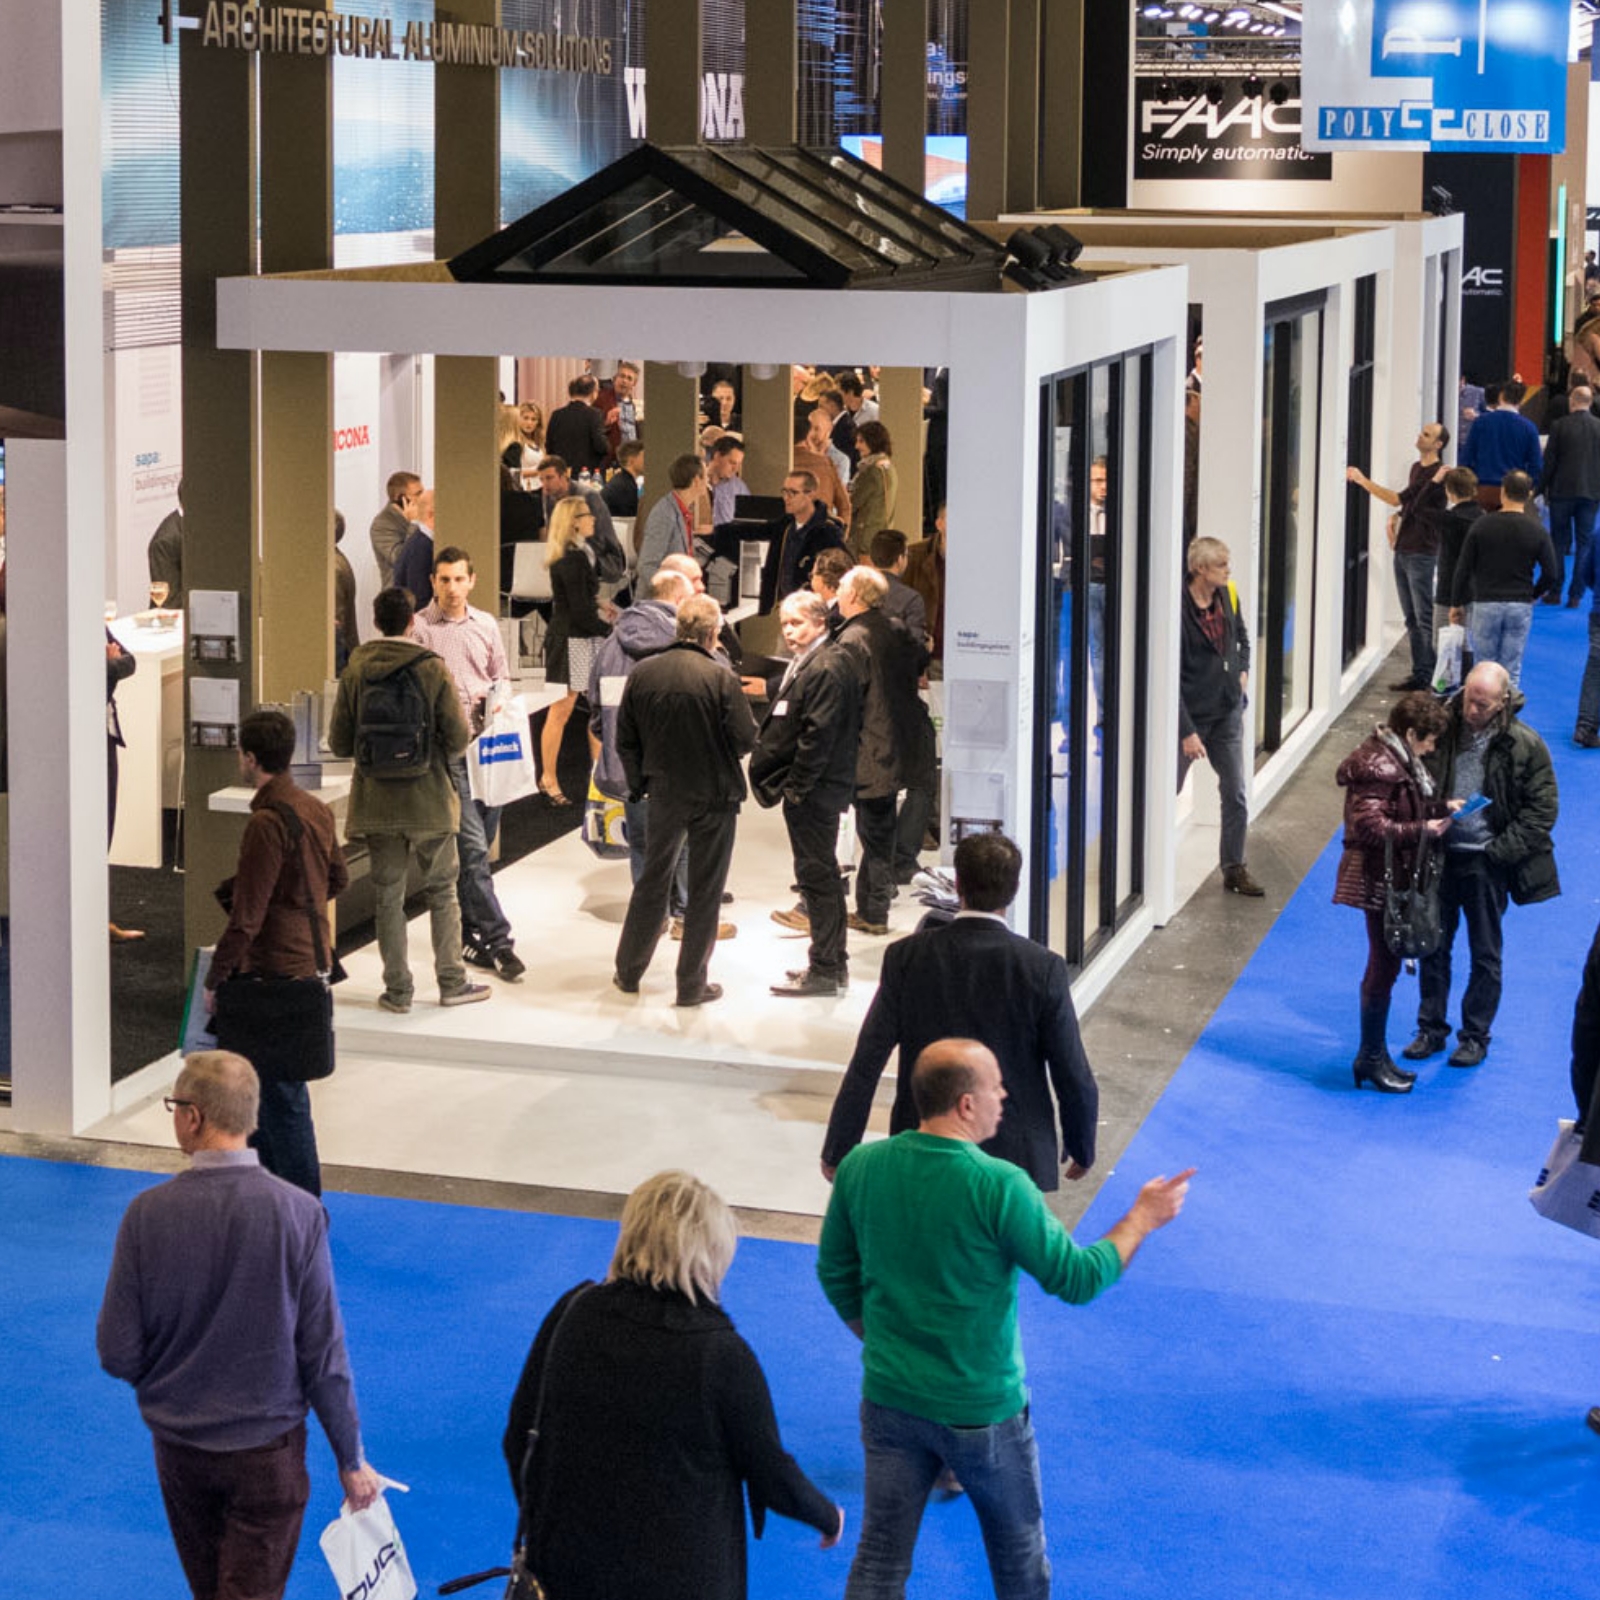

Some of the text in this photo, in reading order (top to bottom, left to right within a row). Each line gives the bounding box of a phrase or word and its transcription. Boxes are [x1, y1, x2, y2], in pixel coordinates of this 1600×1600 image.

[203, 1, 611, 75] ARCHITECTURAL ALUMINIUM SOLUTIONS
[1142, 95, 1302, 139] FAAC
[1325, 110, 1547, 139] POLY CLOSE
[1142, 144, 1315, 163] Simply automatic.
